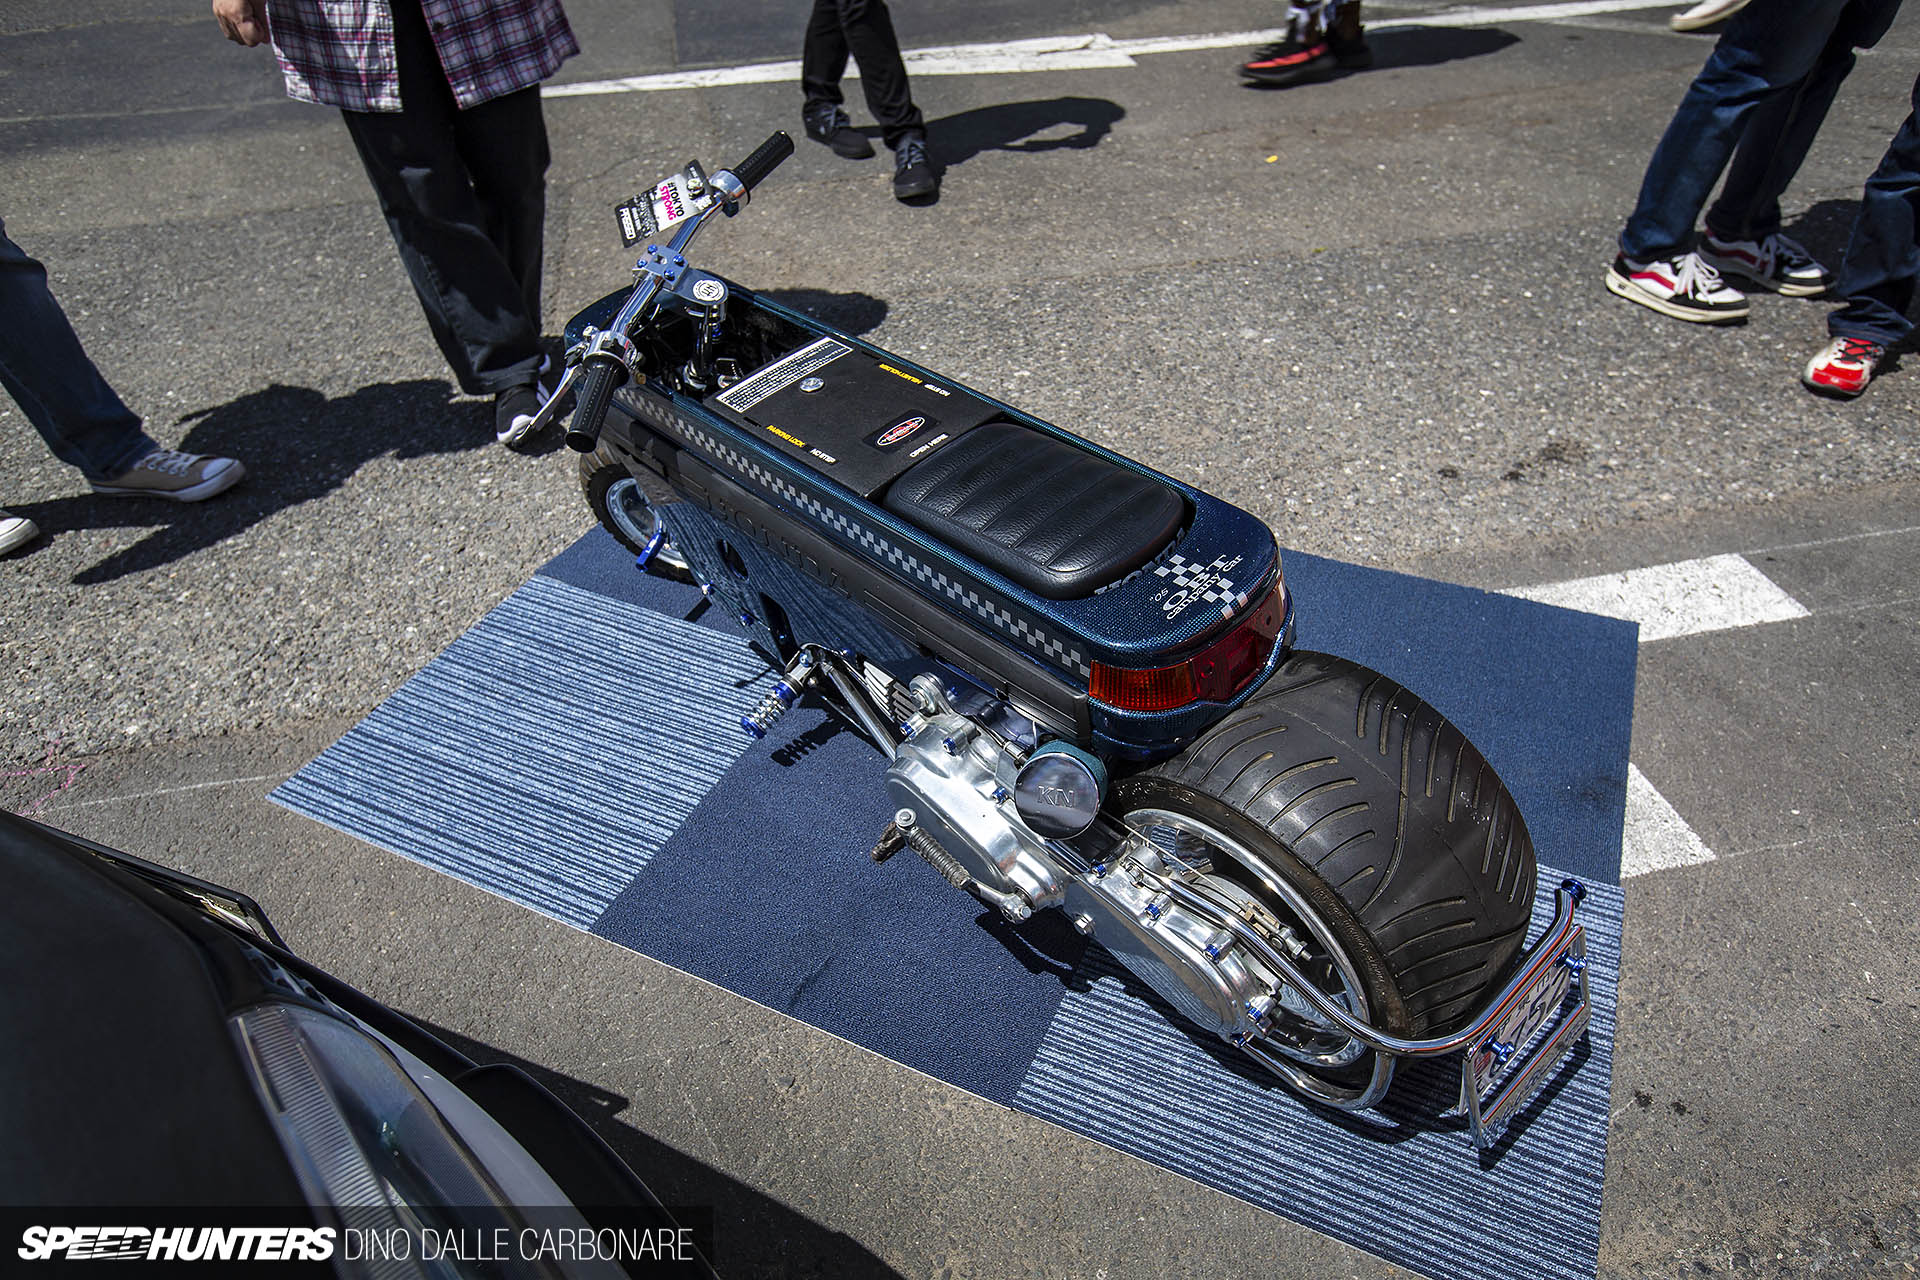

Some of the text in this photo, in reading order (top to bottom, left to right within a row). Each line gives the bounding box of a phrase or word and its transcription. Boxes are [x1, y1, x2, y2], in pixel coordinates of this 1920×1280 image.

[659, 185, 677, 221] STRONG
[667, 182, 685, 217] #TOKYO
[788, 437, 806, 448] LOCK
